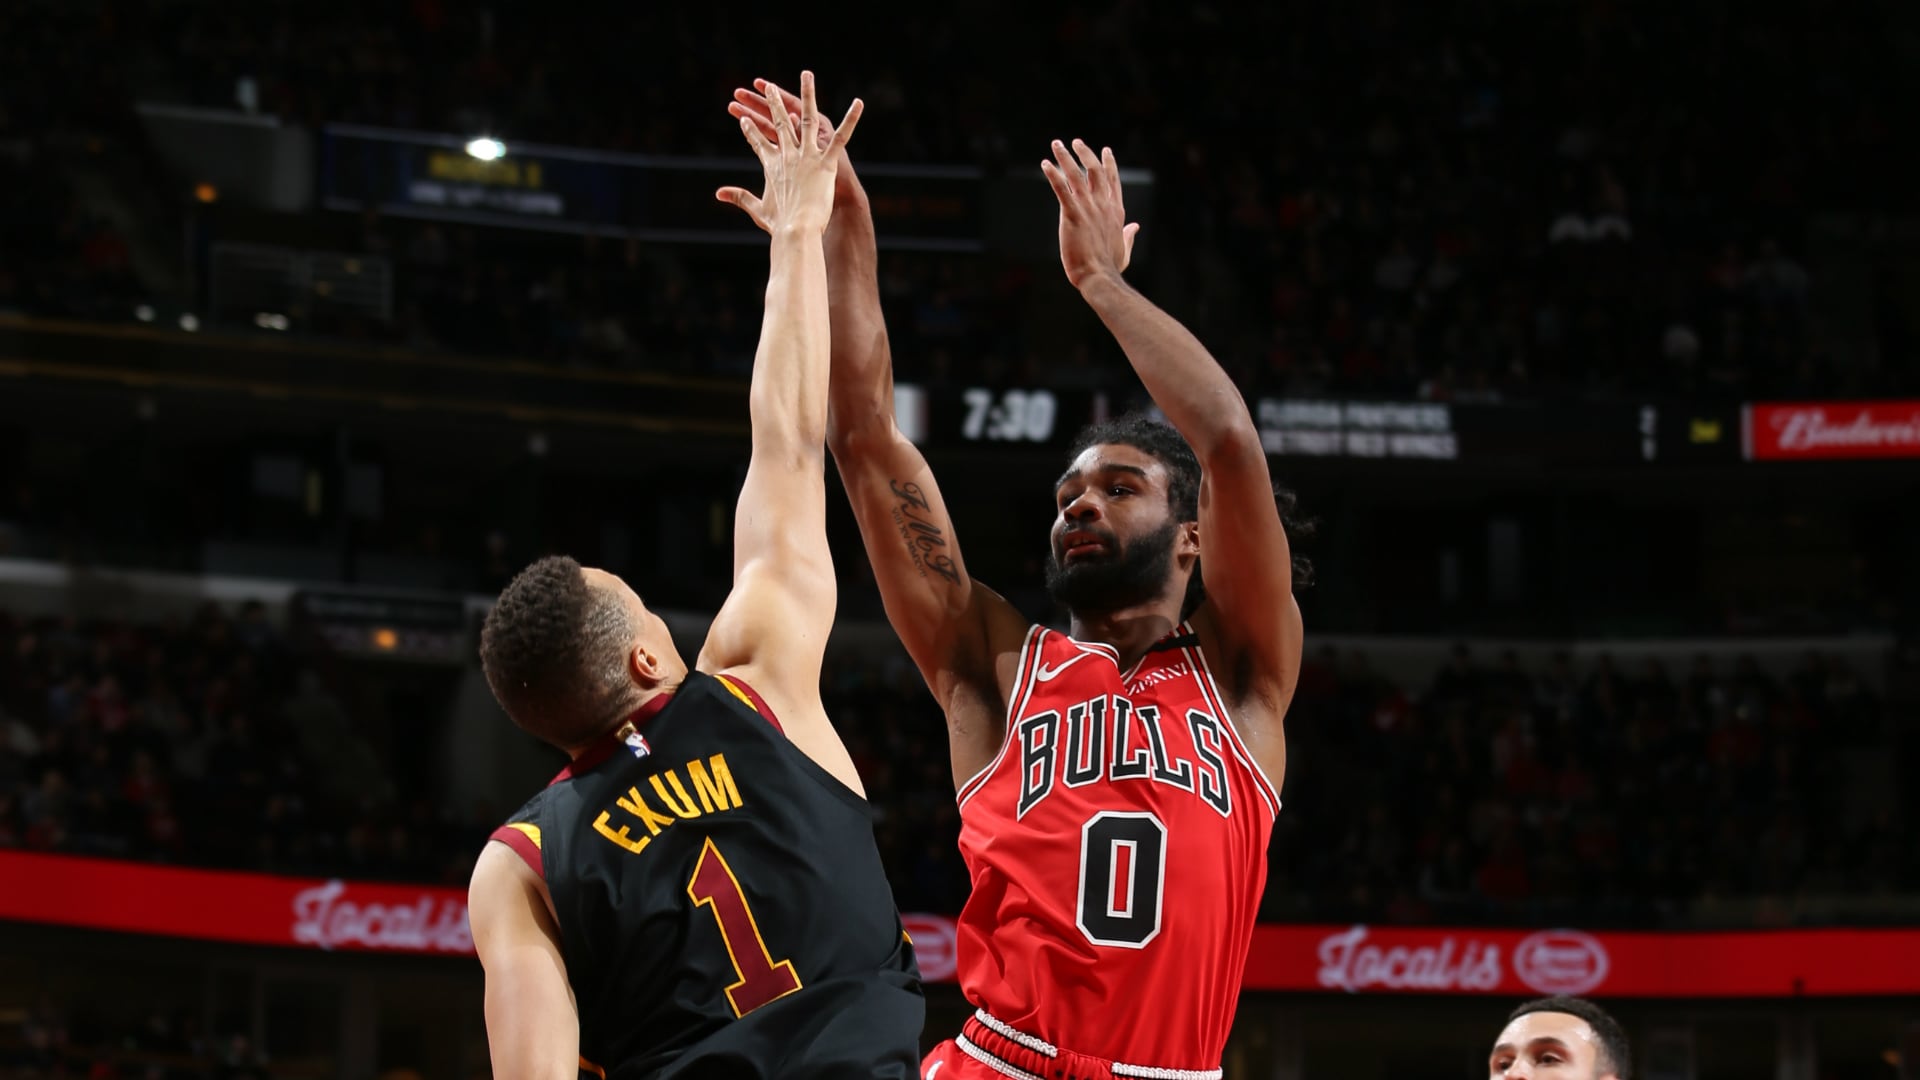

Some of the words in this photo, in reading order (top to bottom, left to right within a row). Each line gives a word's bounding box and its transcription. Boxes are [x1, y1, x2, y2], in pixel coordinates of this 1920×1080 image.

[962, 387, 1057, 442] 7:30
[592, 752, 743, 855] EXUM
[1016, 693, 1232, 823] BULLS
[292, 878, 432, 951] Local
[686, 835, 803, 1018] 1
[1075, 810, 1168, 950] 0
[1317, 924, 1456, 993] Local
[1458, 937, 1503, 991] is
